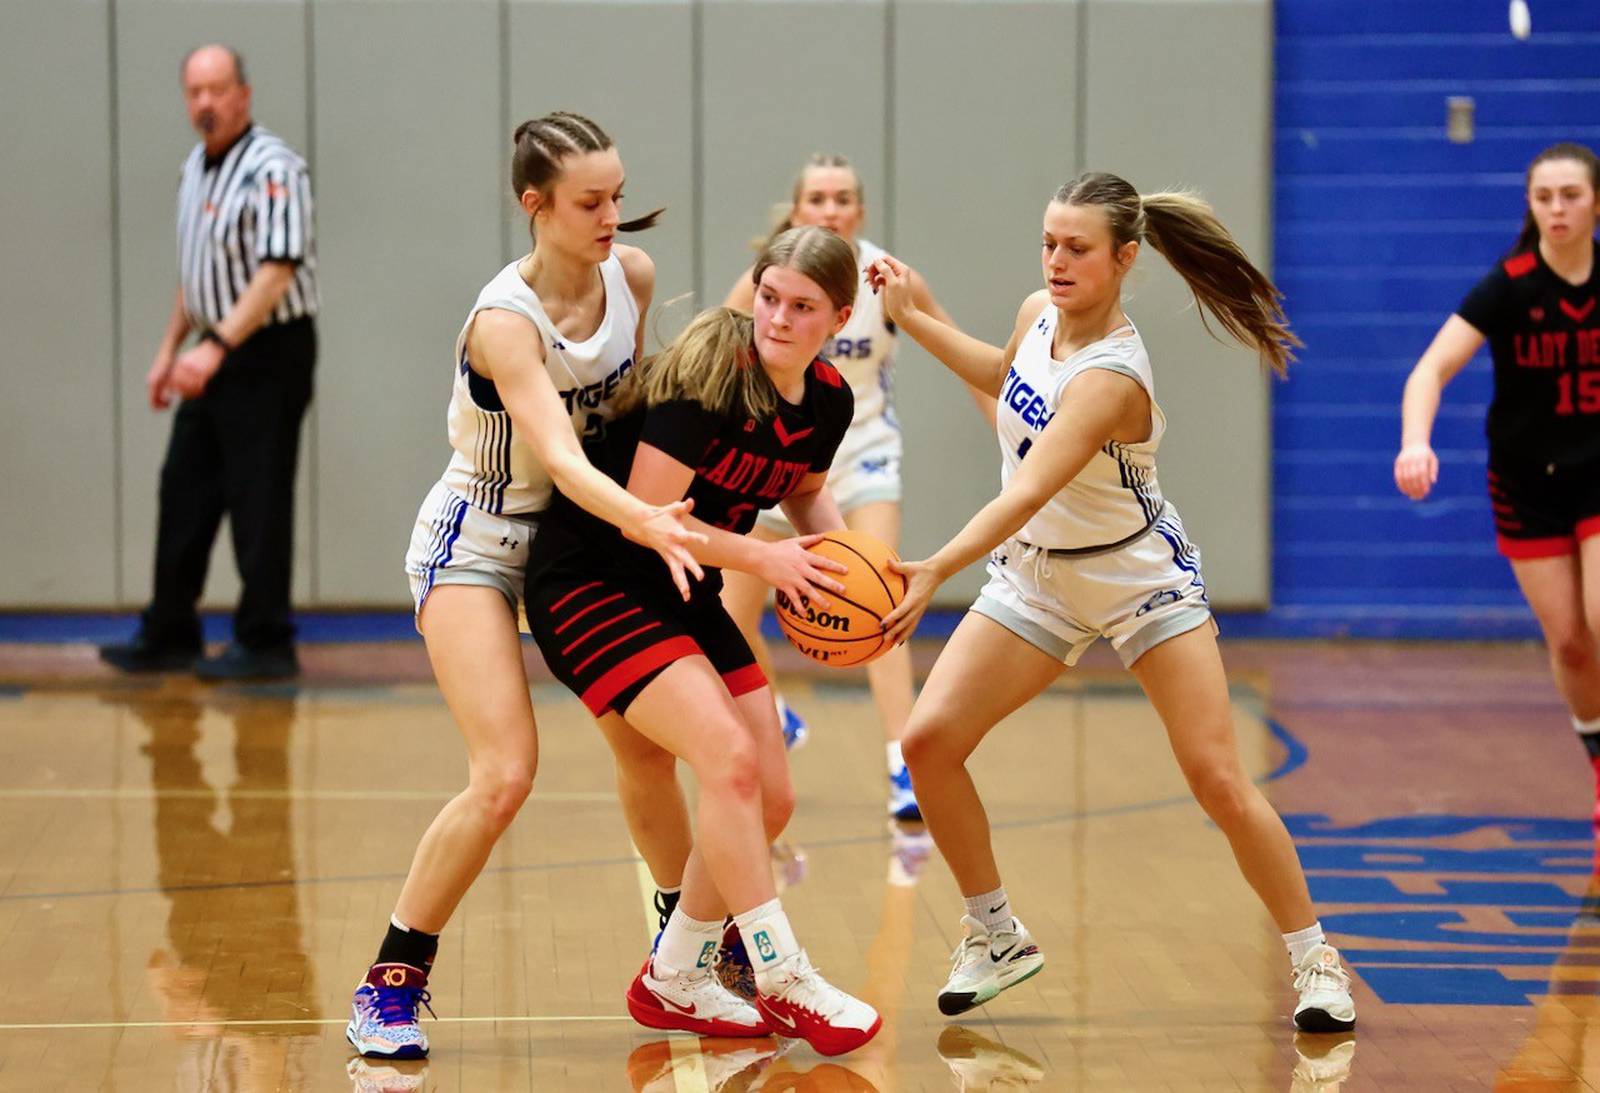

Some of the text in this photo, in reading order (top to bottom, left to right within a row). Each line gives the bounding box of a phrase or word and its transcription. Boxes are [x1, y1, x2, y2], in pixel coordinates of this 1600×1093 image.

[1513, 332, 1568, 368] LADY
[1556, 373, 1600, 415] 15
[695, 438, 768, 495] LADY
